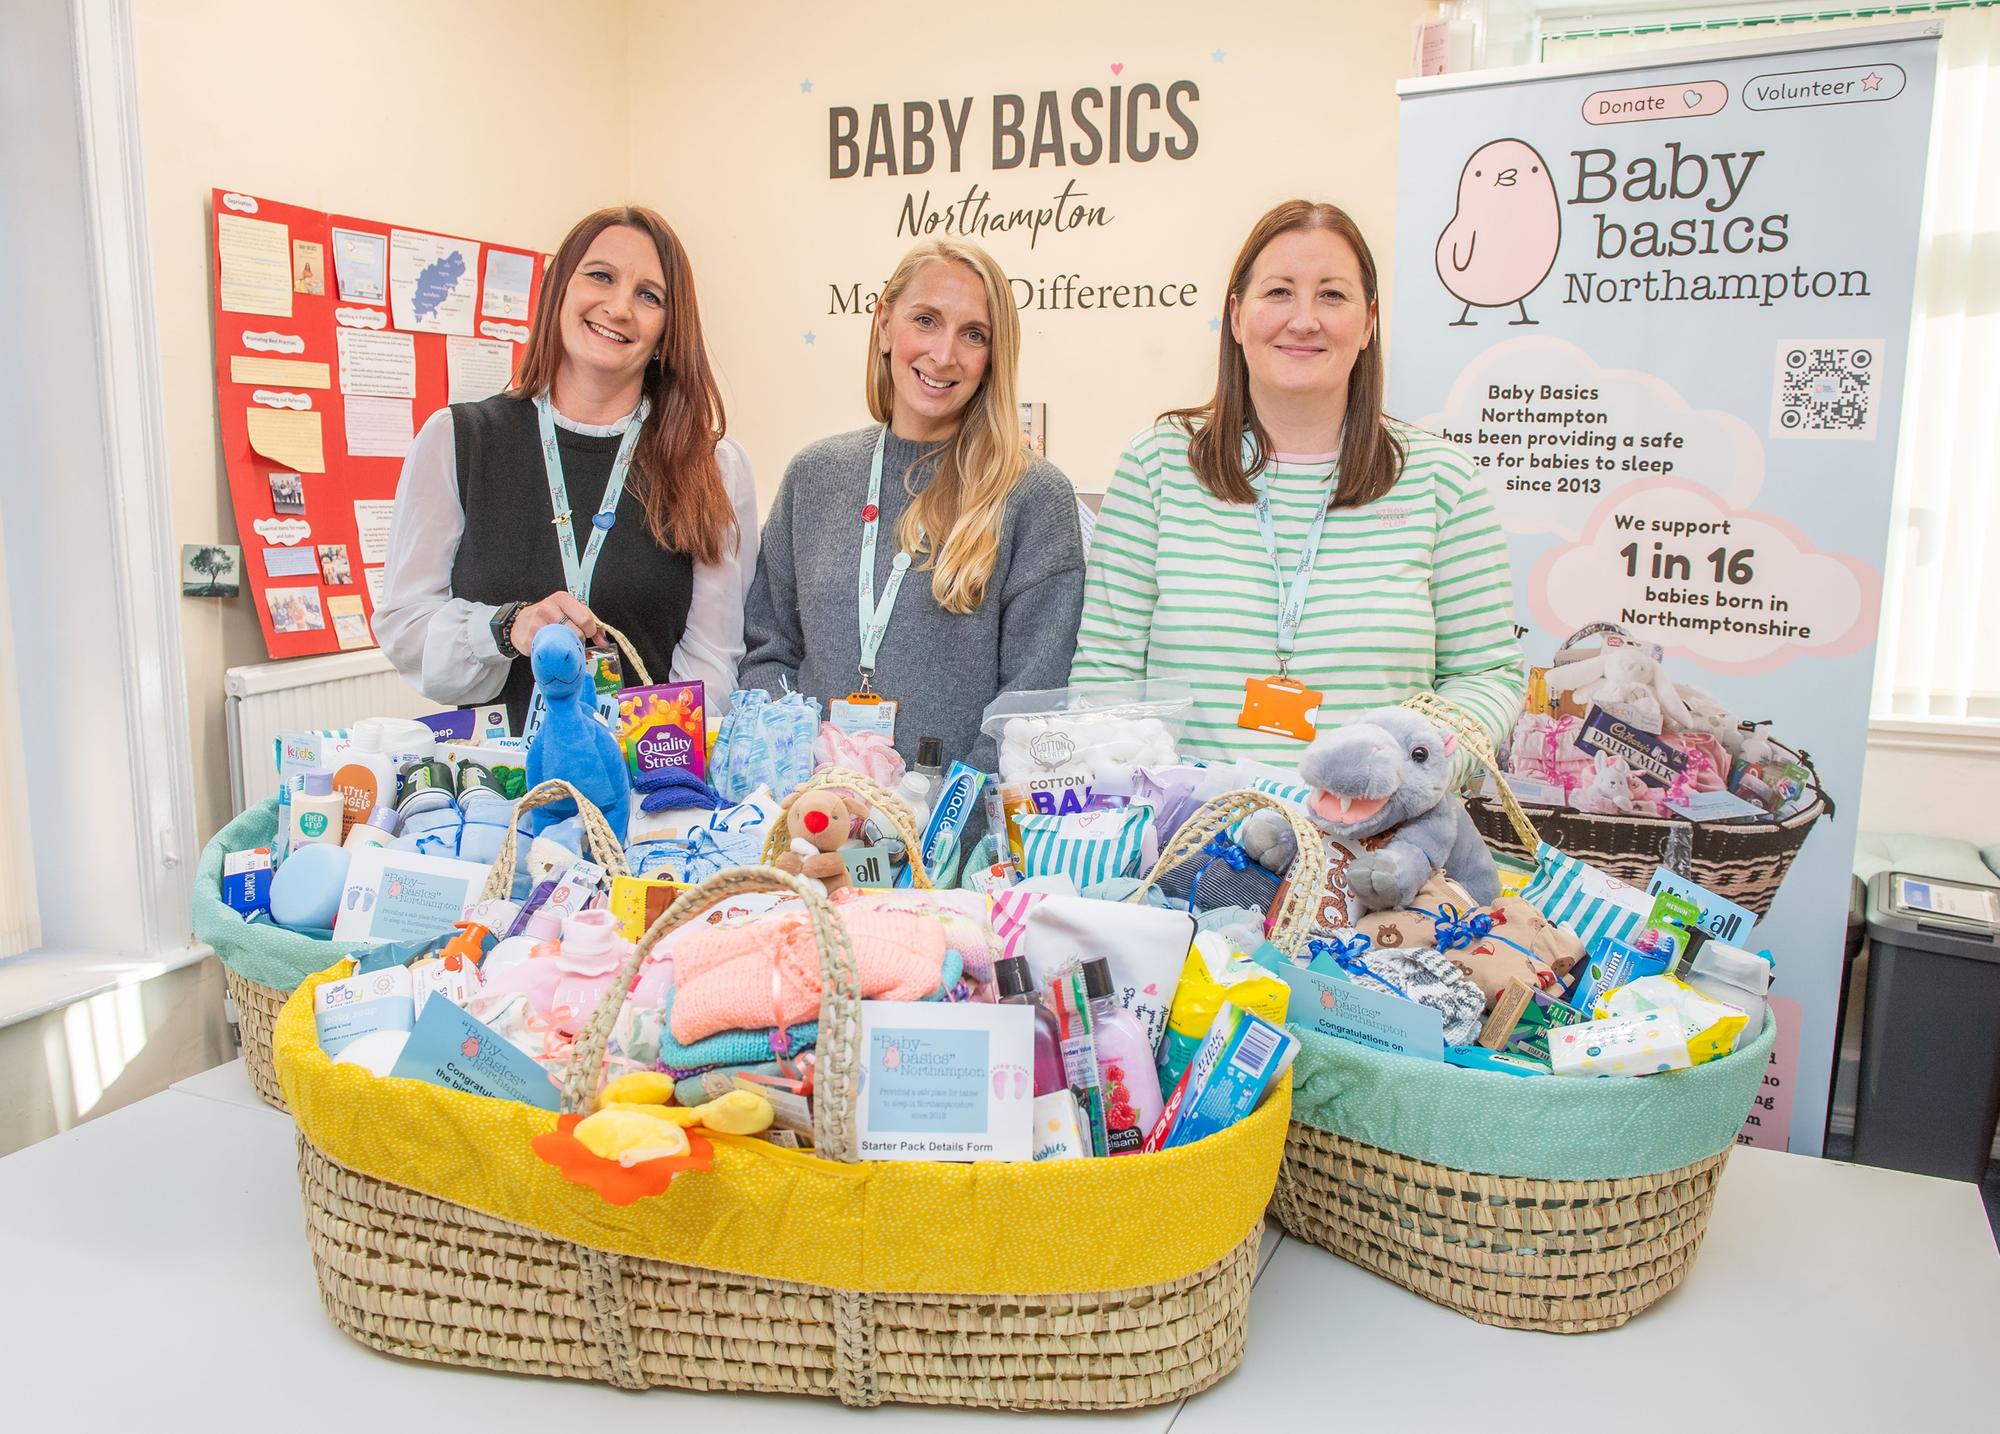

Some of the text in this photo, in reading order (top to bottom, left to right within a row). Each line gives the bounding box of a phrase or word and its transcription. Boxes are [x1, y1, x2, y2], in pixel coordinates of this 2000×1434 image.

[1756, 77, 1855, 102] Volunteer
[1599, 94, 1666, 116] Donate
[828, 79, 1200, 179] BABY BASICS
[1567, 141, 1765, 213] Baby
[896, 178, 1115, 250] Northampton
[1592, 212, 1790, 259] basics
[1008, 273, 1199, 312] Difference
[1562, 264, 1871, 307] Northampton
[1488, 384, 1600, 404] Baby Basics
[1481, 407, 1609, 428] Northampton
[1478, 429, 1523, 446] been
[1527, 430, 1617, 450] providing
[1622, 435, 1634, 448] a
[1640, 432, 1684, 449] safe
[1497, 452, 1525, 469] for
[1530, 453, 1590, 471] babies
[1596, 455, 1616, 471] to
[1621, 455, 1674, 476] sleep
[1505, 475, 1602, 494] since 2013
[1614, 514, 1732, 538] We support
[1619, 541, 1756, 586] 1 in 16
[1645, 585, 1789, 613] babies born in
[1620, 607, 1812, 640] Northamptonshire
[287, 745, 315, 760] kids
[499, 739, 521, 748] new
[637, 737, 692, 756] Quality
[1036, 740, 1068, 753] COTTON
[644, 753, 689, 769] Street
[1592, 730, 1677, 782] DAIRY MILK
[1029, 775, 1085, 790] COTTON
[343, 797, 371, 810] NGELS
[939, 780, 970, 832] macle
[856, 856, 881, 884] all
[399, 893, 462, 913] Northampton
[1710, 913, 1743, 942] all
[1603, 951, 1623, 982] mint
[326, 988, 364, 1005] baby
[1335, 1007, 1408, 1039] Northampton
[1546, 1002, 1576, 1025] FAITH
[1318, 1017, 1390, 1048] Congratulations
[1391, 1042, 1404, 1053] on
[436, 1068, 451, 1084] the
[900, 1065, 985, 1080] Northampton
[861, 1140, 994, 1152] Starter Pack Details Form
